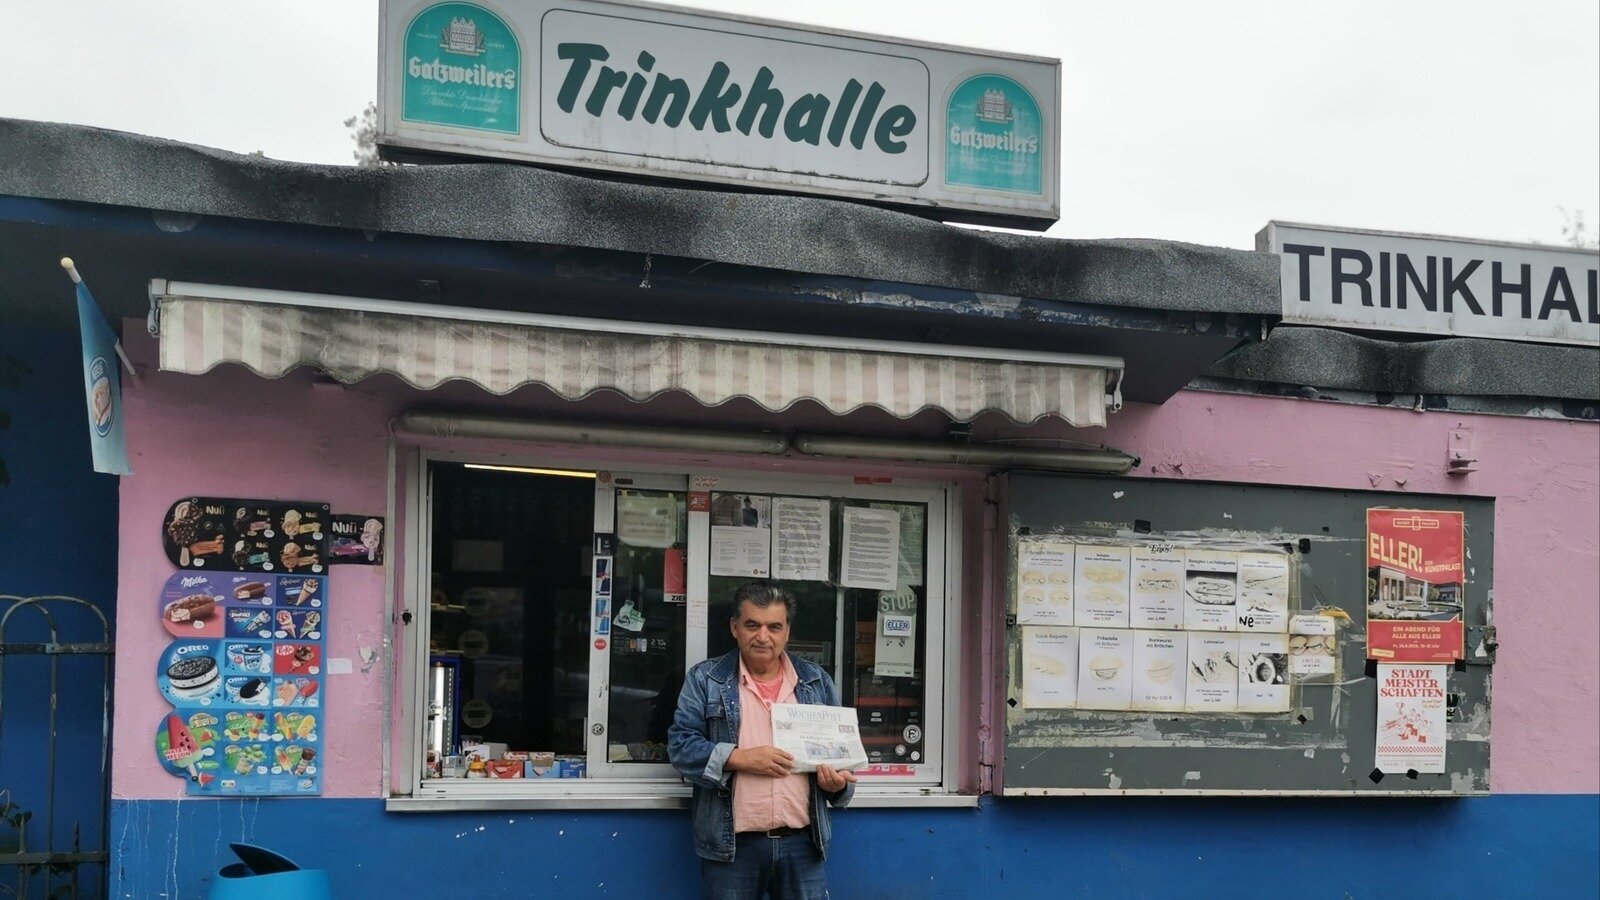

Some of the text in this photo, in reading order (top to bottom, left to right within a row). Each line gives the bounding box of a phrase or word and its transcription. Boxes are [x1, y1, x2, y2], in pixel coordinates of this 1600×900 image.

[409, 56, 516, 90] Gatzweilers
[557, 43, 917, 154] Trinkhalle
[950, 122, 1039, 153] Gatzweilers
[332, 521, 357, 534] Nuii
[1370, 532, 1423, 573] ELLER!
[181, 575, 208, 587] Milka
[880, 592, 915, 612] STOP
[177, 644, 209, 655] OREO
[1391, 668, 1432, 679] STADT
[1385, 679, 1438, 688] MEISTER
[1380, 688, 1443, 698] SCHAFTEN
